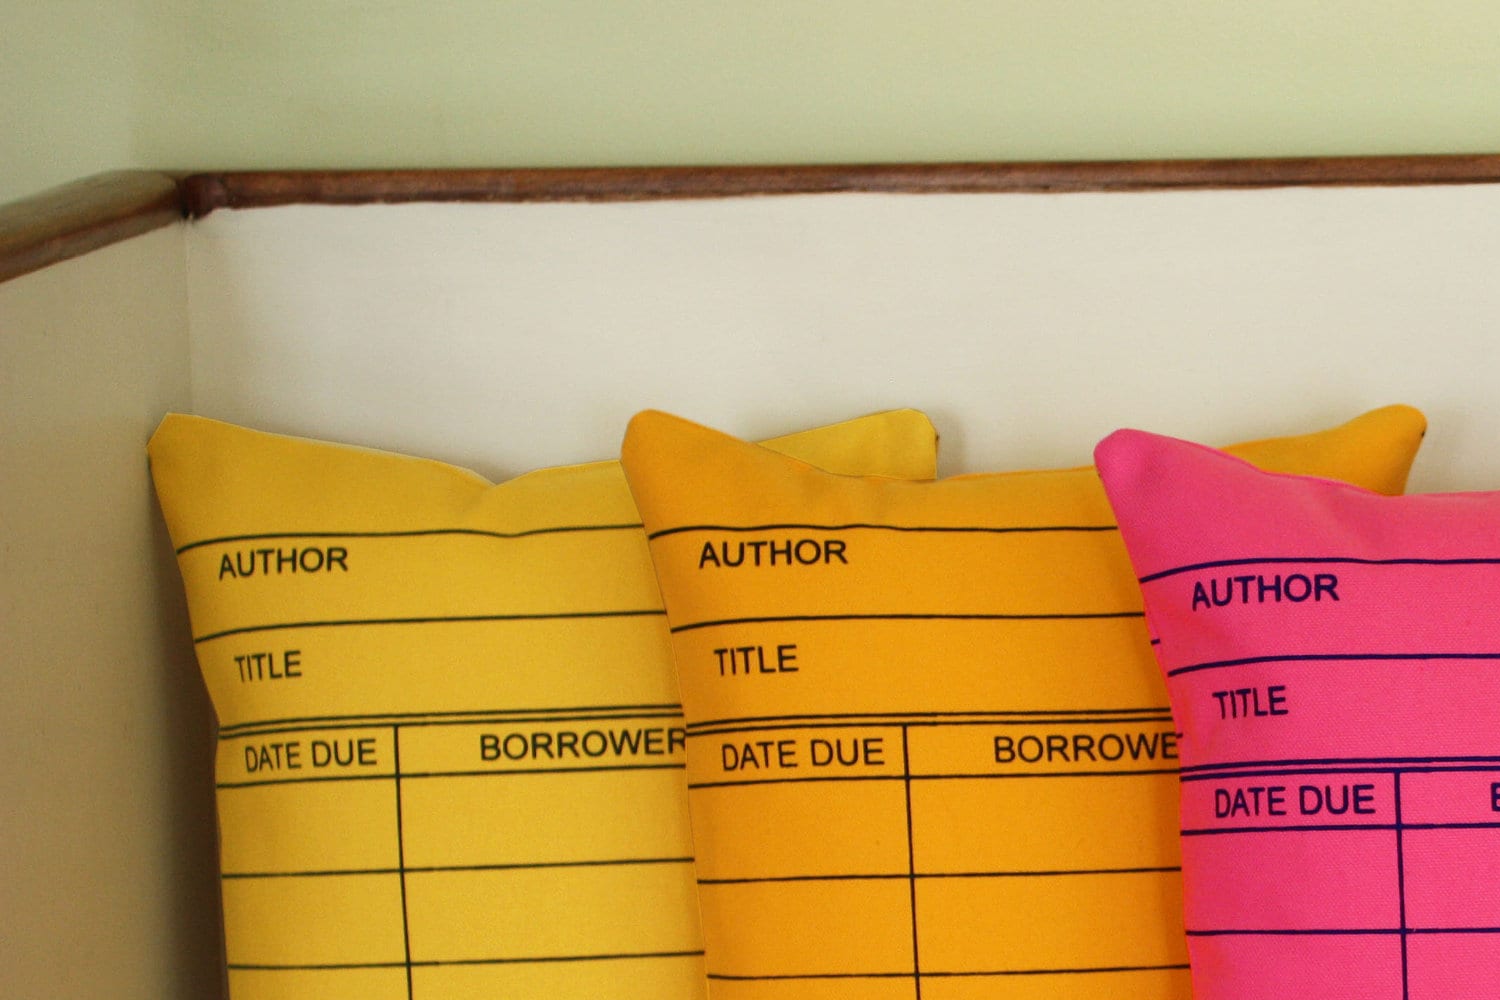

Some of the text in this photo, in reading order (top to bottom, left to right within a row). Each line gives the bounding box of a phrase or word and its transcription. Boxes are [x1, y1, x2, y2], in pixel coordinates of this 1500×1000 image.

[219, 547, 348, 580] AUTHOR
[699, 539, 848, 569] AUTHOR
[1192, 573, 1340, 611] AUTHOR
[234, 649, 302, 683] TITLE
[714, 645, 799, 677] TITLE
[1212, 685, 1289, 720] TITLE
[245, 738, 378, 774] DATE DUE
[722, 737, 885, 772] DATE DUE
[994, 731, 1179, 764] BORROWE
[1214, 784, 1376, 819] DATE DUE
